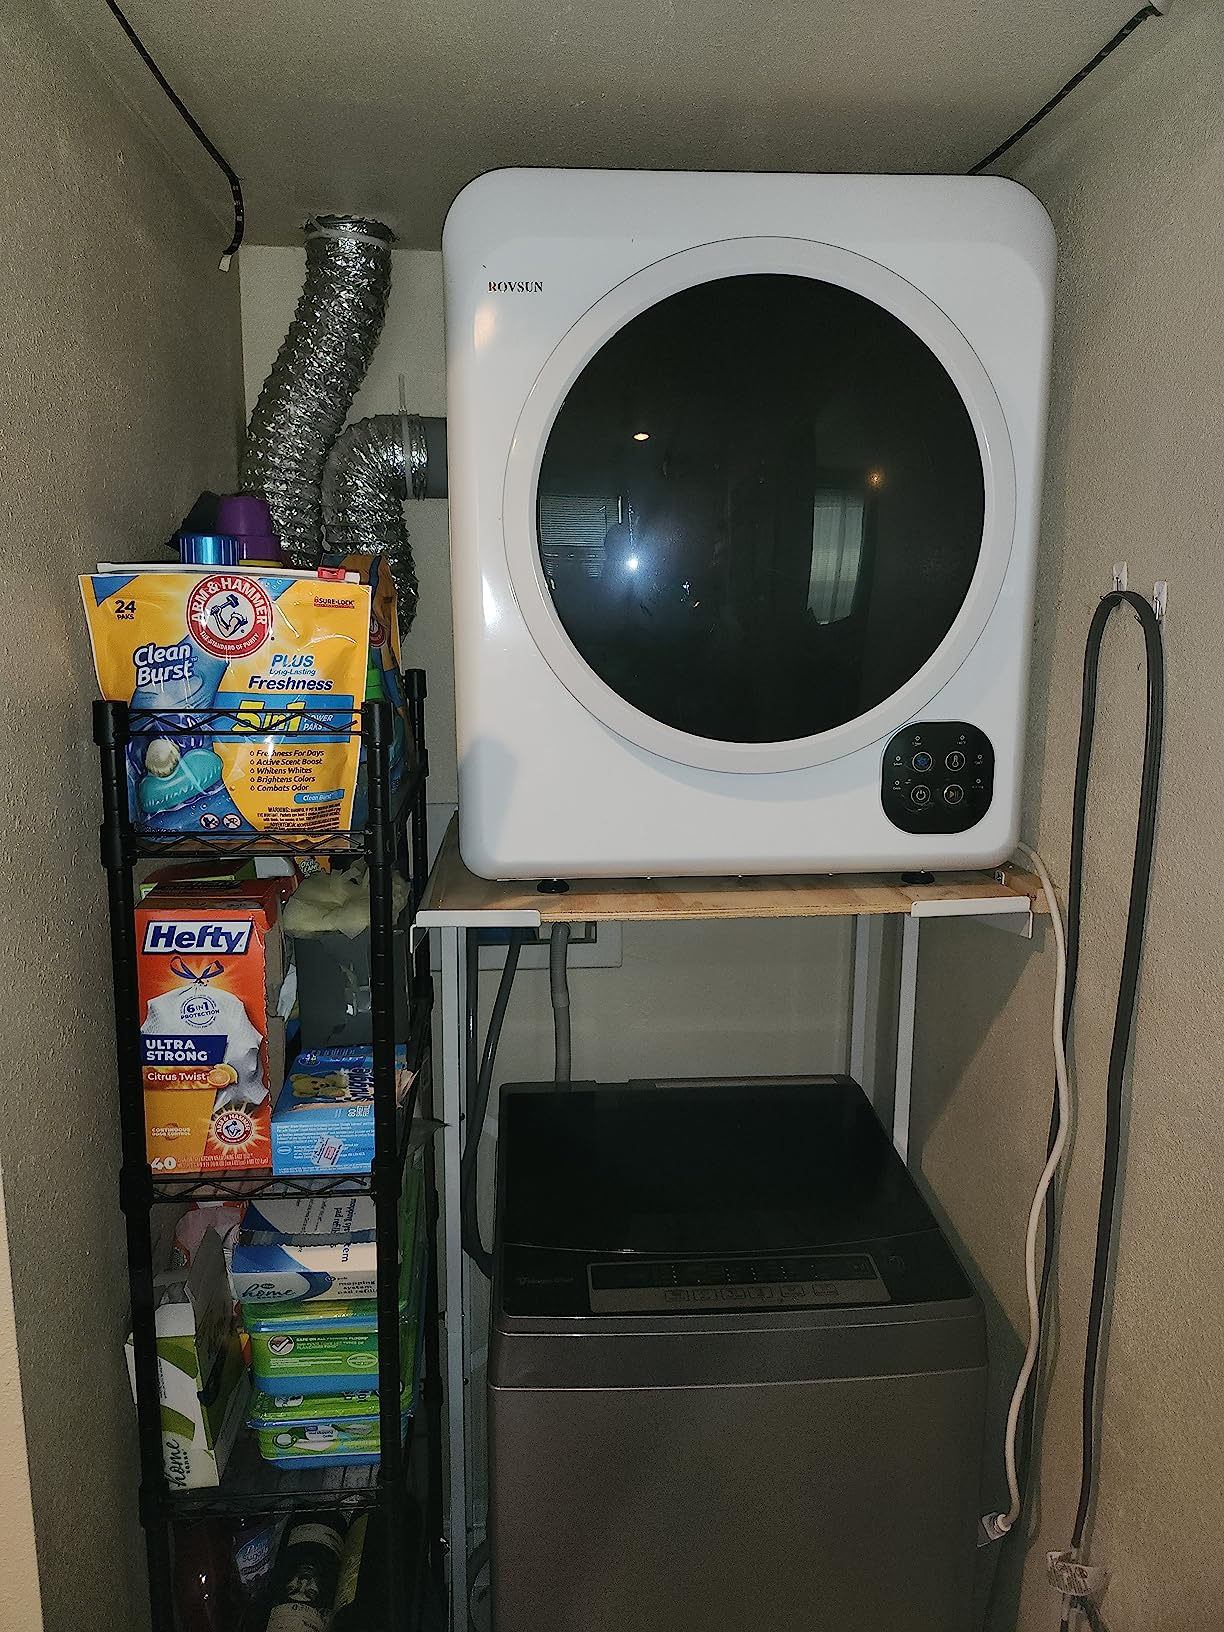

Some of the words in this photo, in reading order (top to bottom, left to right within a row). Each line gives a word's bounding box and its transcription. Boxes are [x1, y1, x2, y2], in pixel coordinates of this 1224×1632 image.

[488, 281, 543, 293] ROVSUN
[114, 600, 136, 613] 24
[191, 587, 211, 623] ARM
[206, 581, 221, 594] &
[220, 577, 268, 626] HAMMER
[206, 637, 236, 651] STANDARD
[243, 632, 260, 649] PURITY
[134, 643, 191, 666] Clean
[271, 654, 315, 668] PLUS
[136, 660, 193, 686] Burst
[269, 668, 316, 677] Long-Lasting
[248, 675, 334, 691] Freshness
[306, 750, 324, 758] Days
[256, 767, 287, 775] Whitens
[256, 776, 292, 784] Brightens
[150, 925, 246, 953] Hefty
[186, 1004, 195, 1013] 6
[203, 1001, 209, 1010] 1
[180, 1009, 220, 1020] PROTECTION
[146, 1039, 196, 1050] ULTRA
[146, 1051, 208, 1062] STRONG
[147, 1072, 178, 1081] Citrus
[178, 1072, 206, 1081] Twist
[151, 1157, 177, 1170] 40
[241, 1283, 297, 1298] home
[163, 1438, 187, 1488] home
